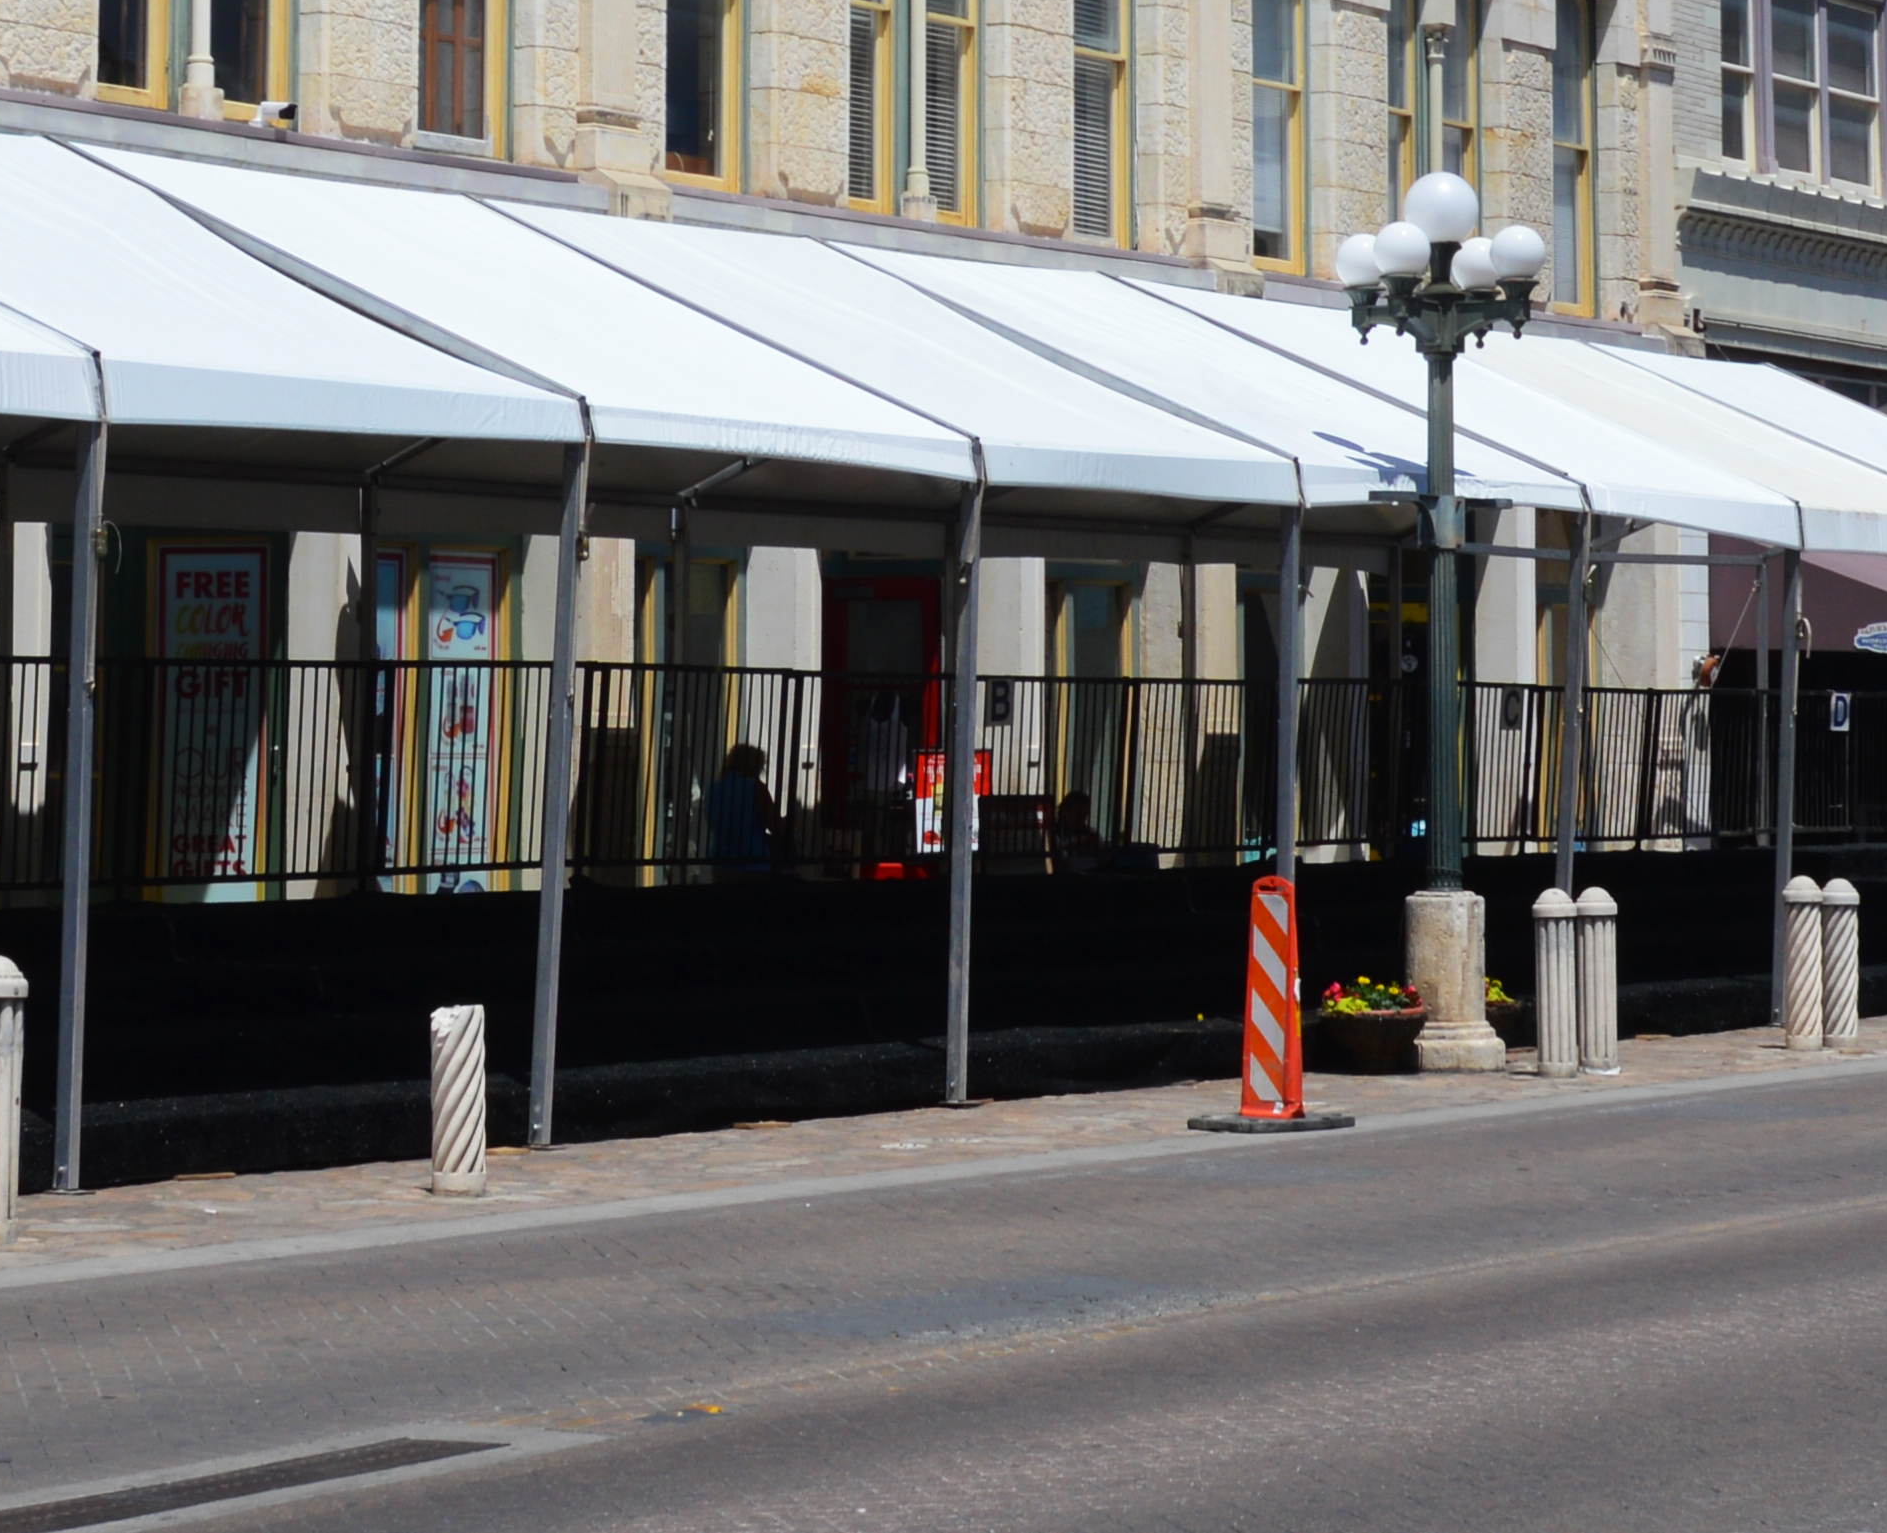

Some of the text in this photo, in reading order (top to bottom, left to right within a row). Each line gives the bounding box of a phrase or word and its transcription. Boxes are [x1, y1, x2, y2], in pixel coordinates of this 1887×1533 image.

[176, 571, 251, 599] FREE
[175, 603, 249, 638] COLOR
[174, 670, 249, 699] GIFT
[991, 680, 1011, 722] B
[1505, 689, 1520, 728] C
[1834, 695, 1848, 727] D
[174, 746, 248, 780] OUR
[174, 803, 248, 828] MAKE
[173, 834, 248, 854] GREAT
